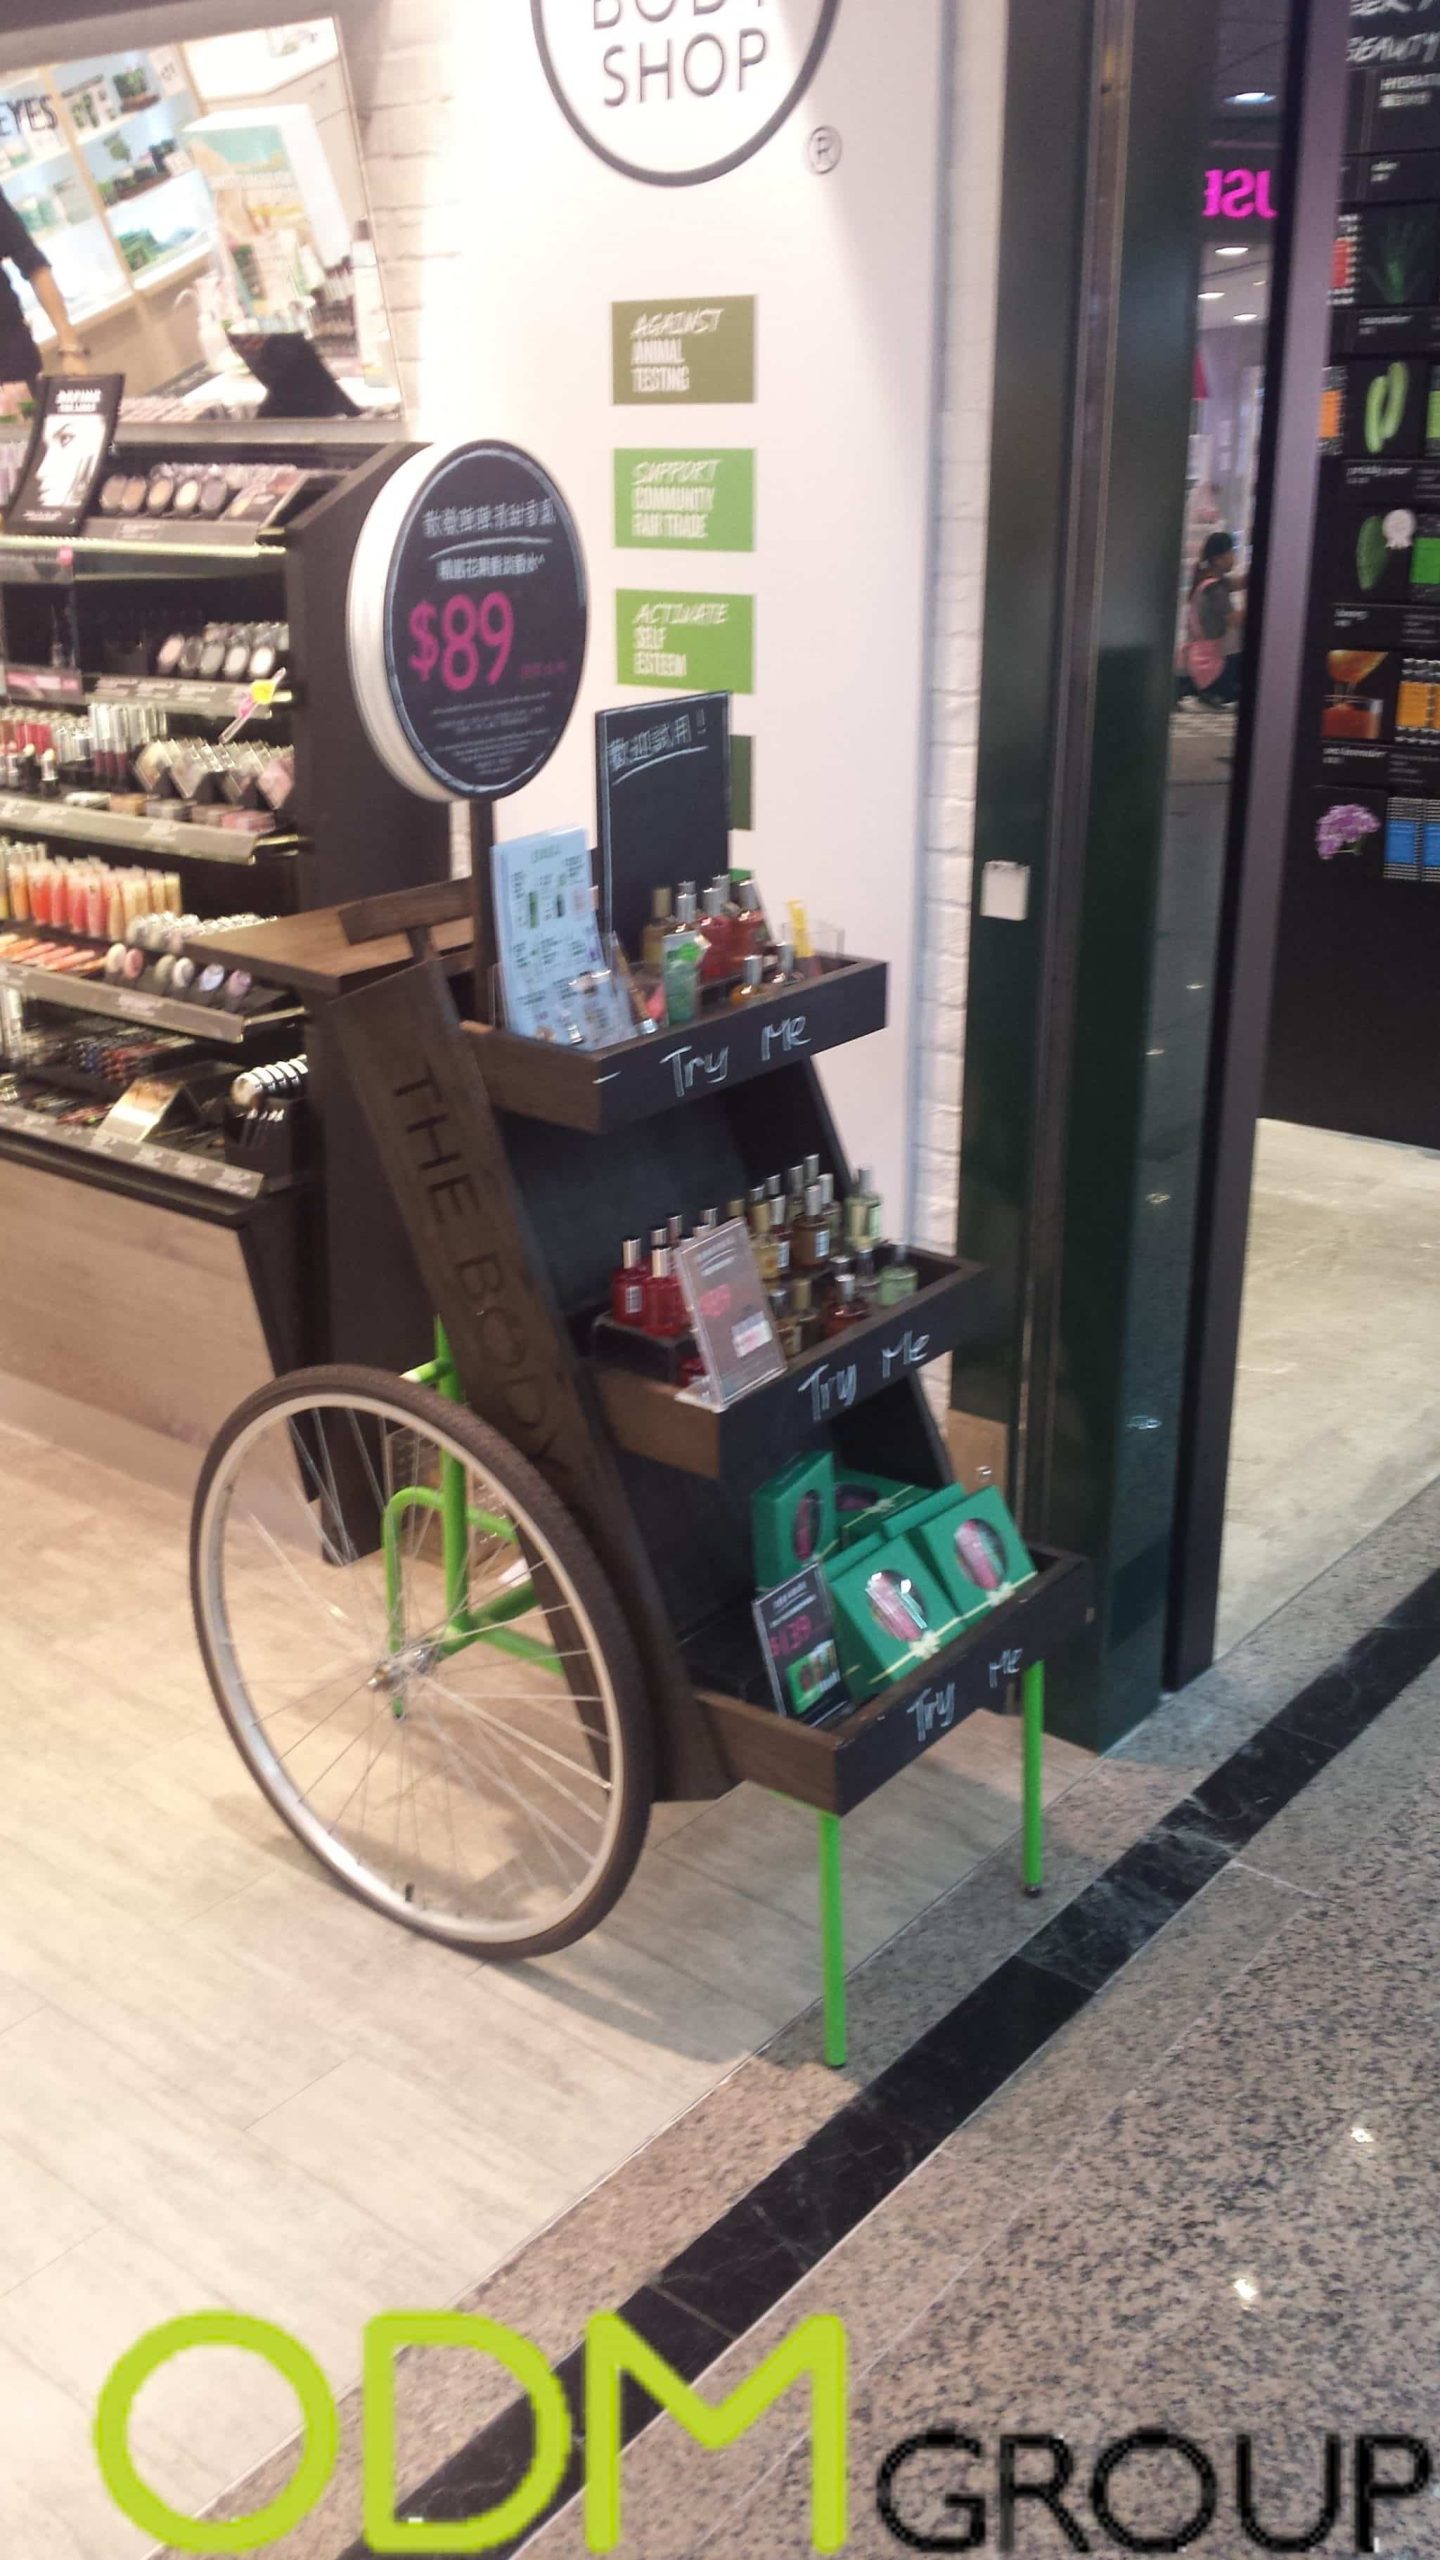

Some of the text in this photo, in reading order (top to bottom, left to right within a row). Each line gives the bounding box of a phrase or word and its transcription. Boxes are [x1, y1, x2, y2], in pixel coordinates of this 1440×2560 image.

[602, 27, 768, 108] SHOP
[630, 307, 726, 339] AGAINST
[631, 458, 721, 486] SUPPORT
[408, 590, 515, 692] $89
[633, 602, 730, 626] ACTIVATE
[659, 1015, 812, 1098] Try Me
[394, 1066, 477, 1222] THE
[797, 1363, 858, 1423] Try
[906, 1681, 956, 1742] Try
